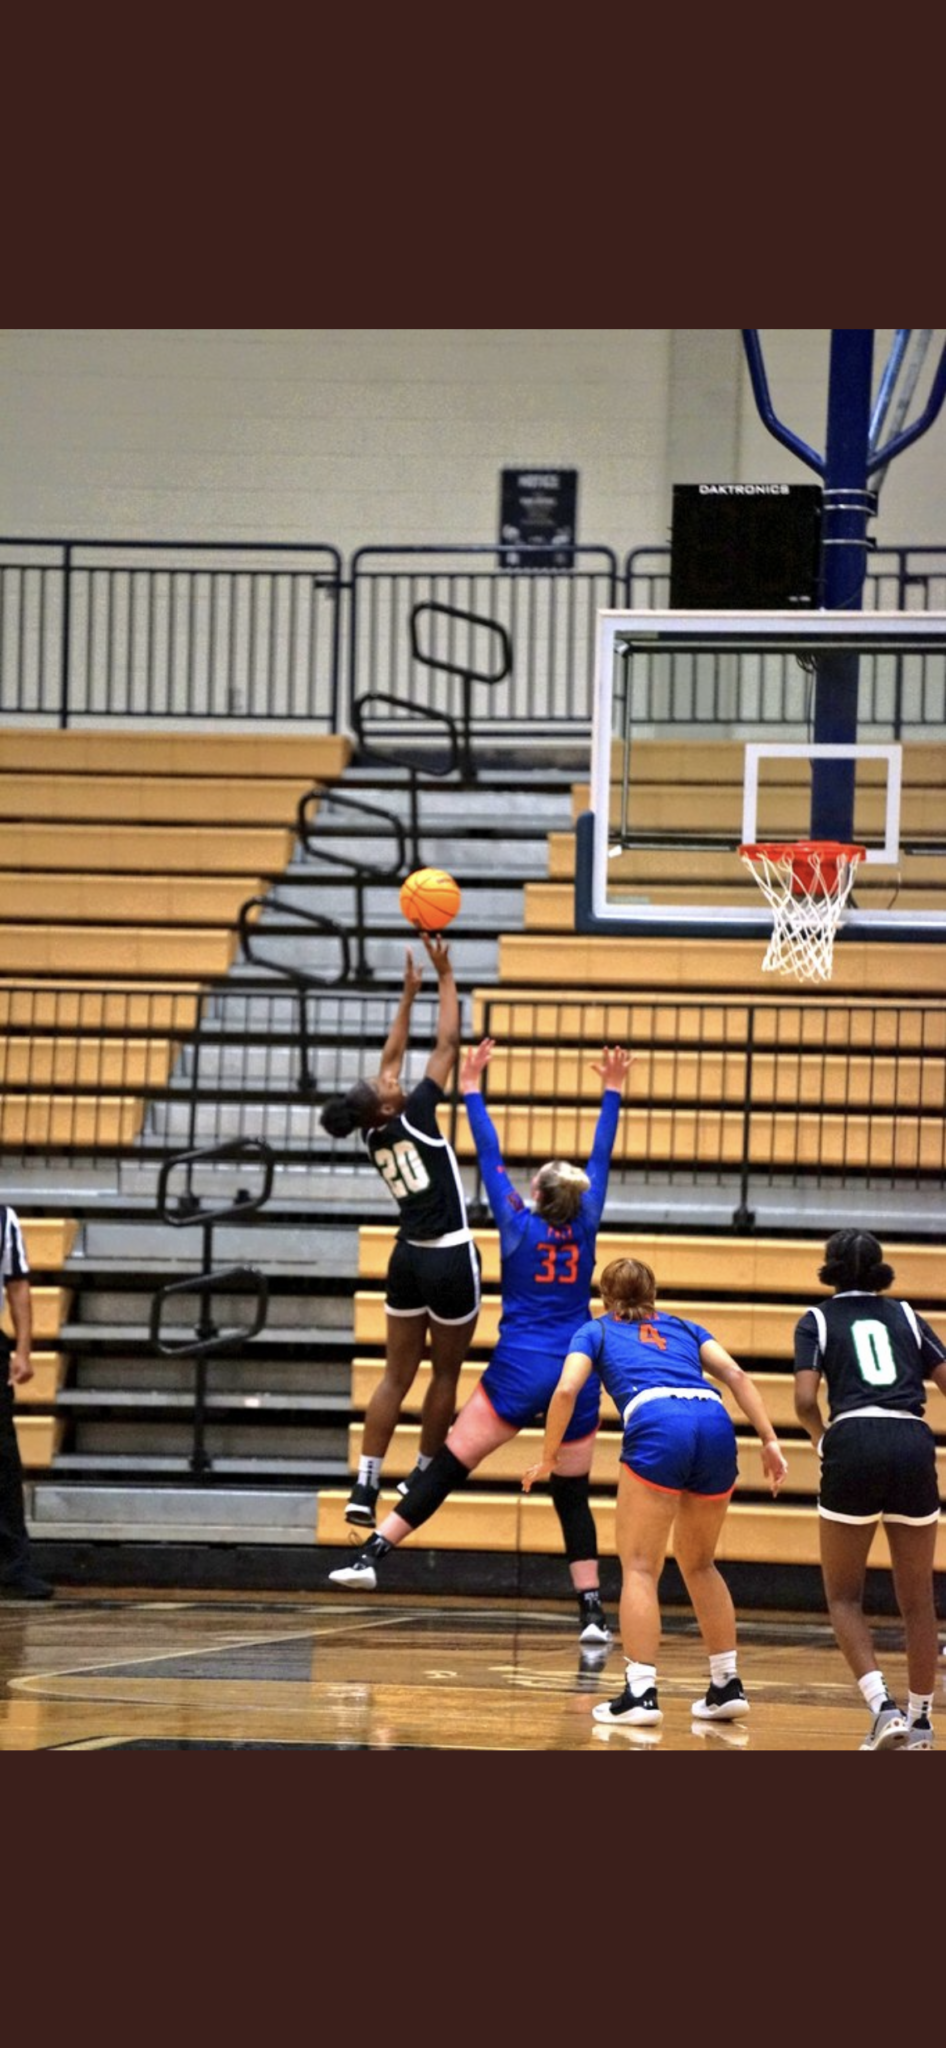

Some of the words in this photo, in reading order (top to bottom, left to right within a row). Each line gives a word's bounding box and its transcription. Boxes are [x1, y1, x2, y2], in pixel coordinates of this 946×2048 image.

[699, 483, 790, 496] DAKTRONICS
[374, 1140, 431, 1198] 20
[534, 1242, 580, 1283] 33
[638, 1323, 667, 1351] 4
[850, 1318, 898, 1386] 0
